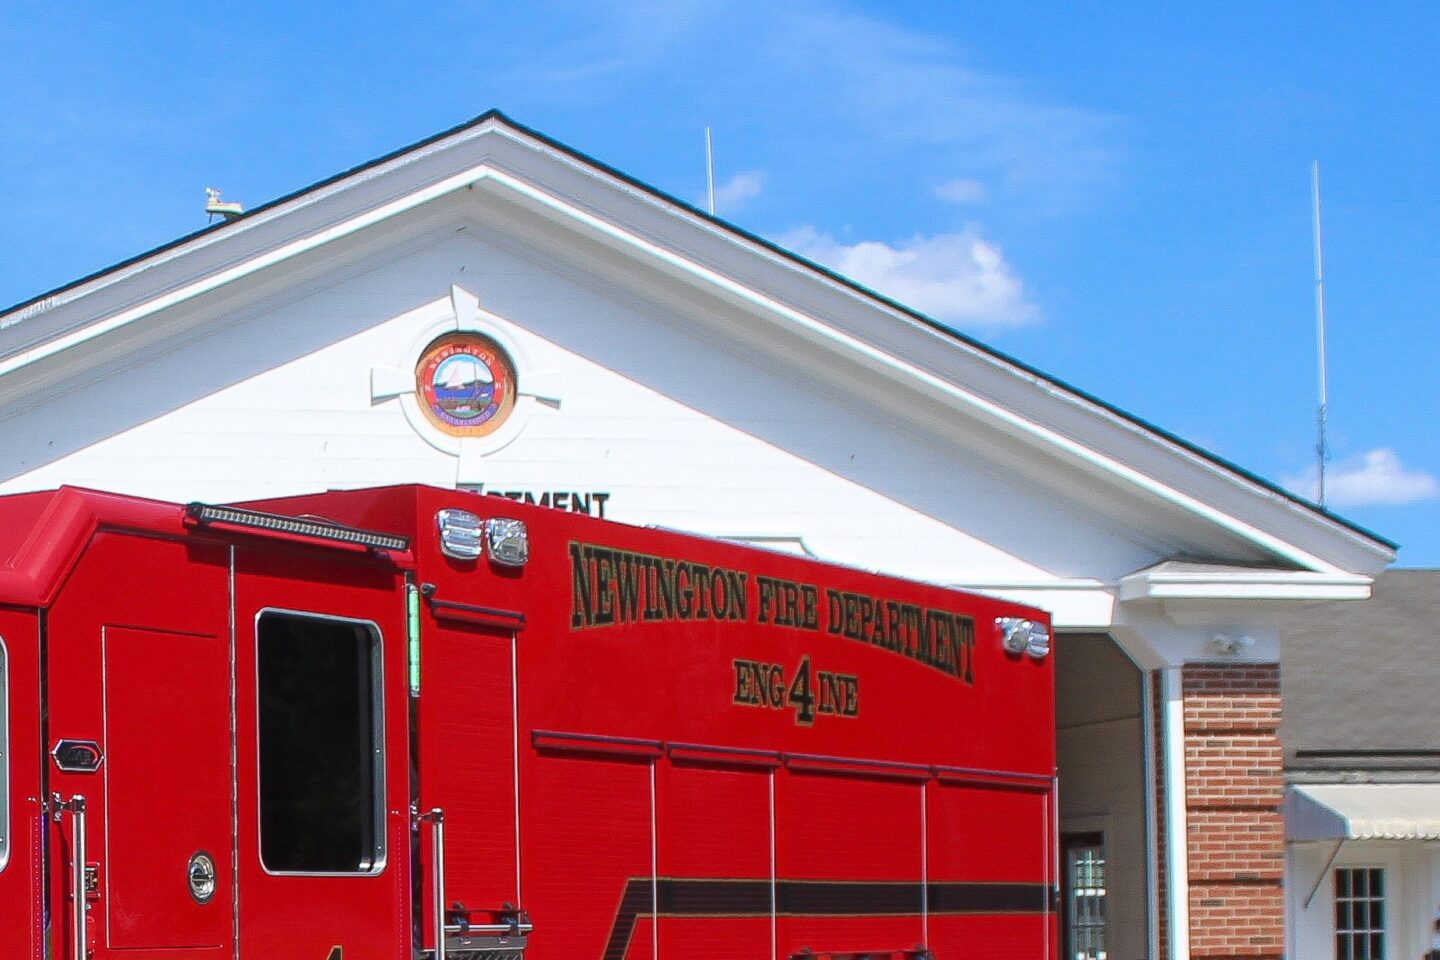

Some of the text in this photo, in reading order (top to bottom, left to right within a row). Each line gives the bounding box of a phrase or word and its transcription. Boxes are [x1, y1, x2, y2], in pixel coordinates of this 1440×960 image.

[568, 540, 975, 687] NEWINGTON FIRE DEPARTMENT
